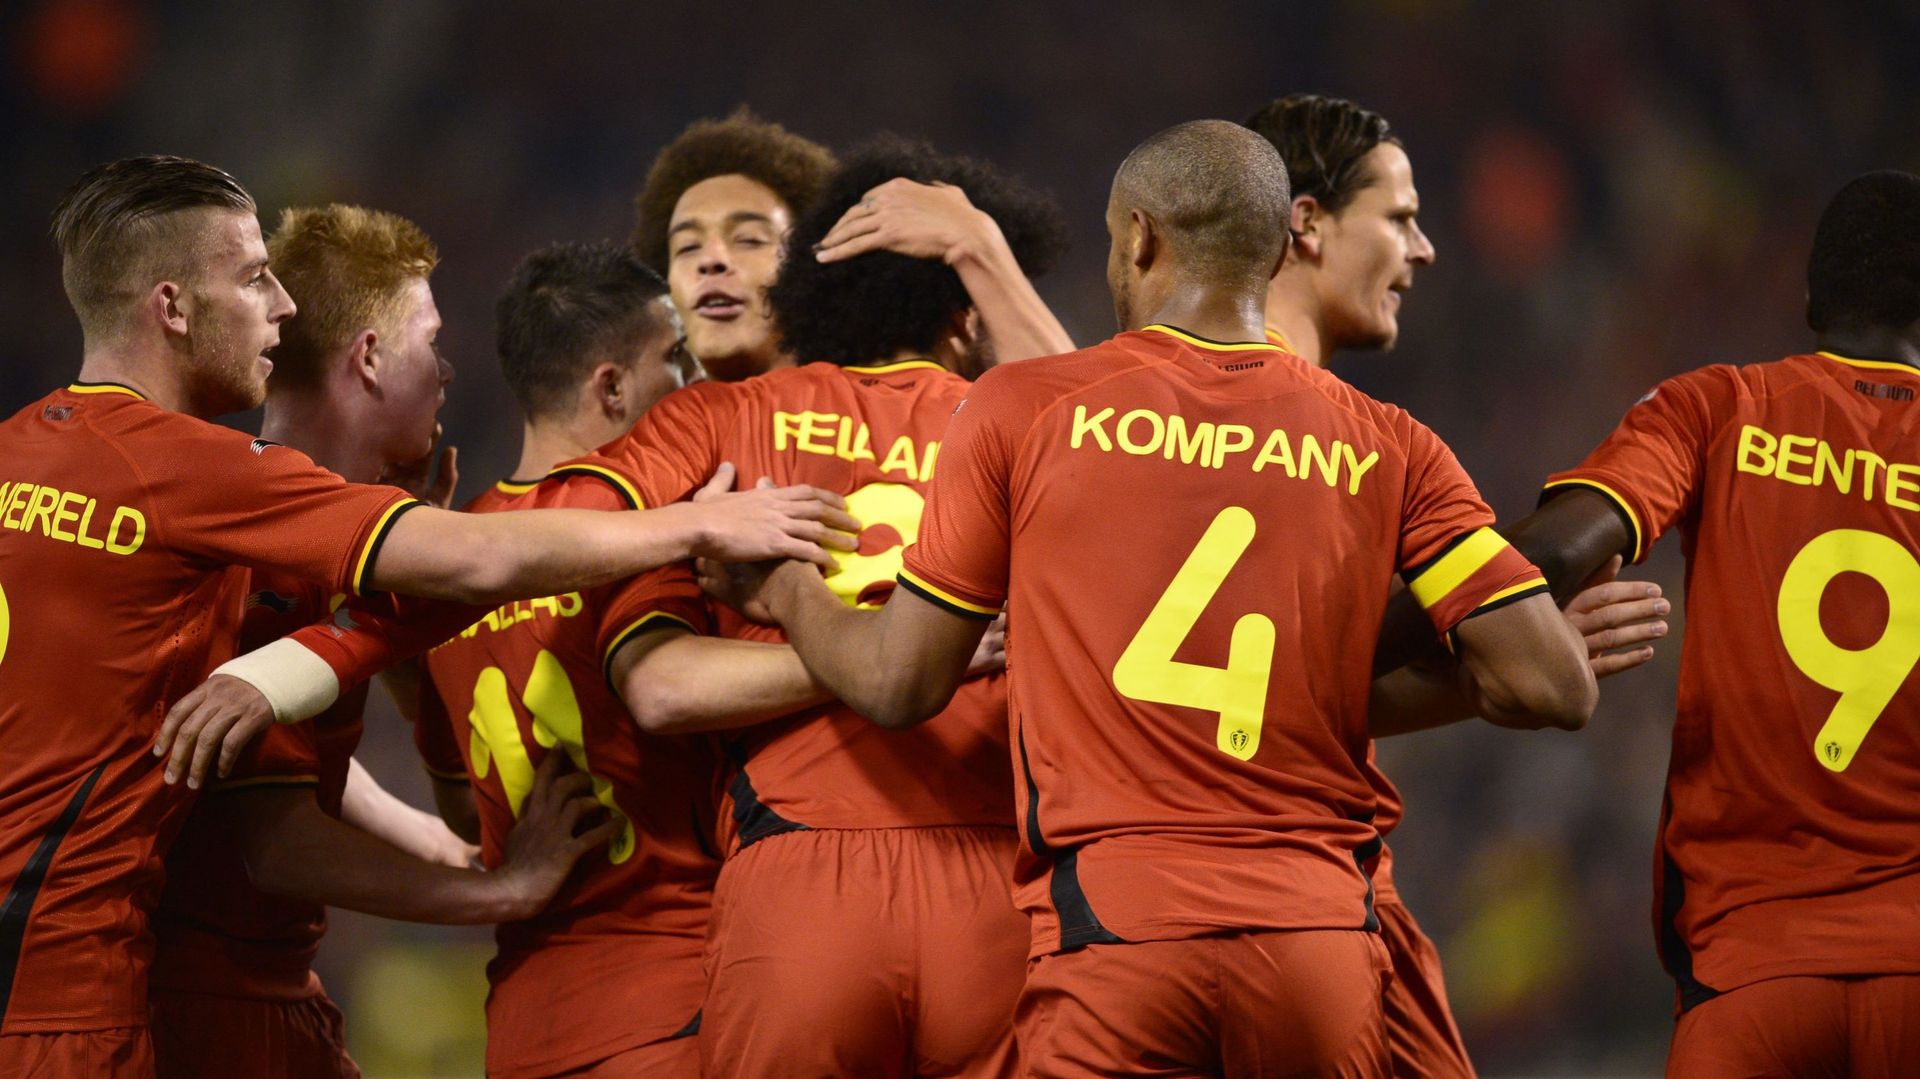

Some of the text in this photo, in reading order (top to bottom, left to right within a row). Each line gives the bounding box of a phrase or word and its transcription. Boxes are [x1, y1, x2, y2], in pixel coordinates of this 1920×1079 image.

[773, 410, 943, 483] FELLAI
[1070, 405, 1380, 496] KOMPANY
[1736, 424, 1920, 513] BENTE
[1112, 505, 1277, 762] 4
[1777, 528, 1920, 773] 9
